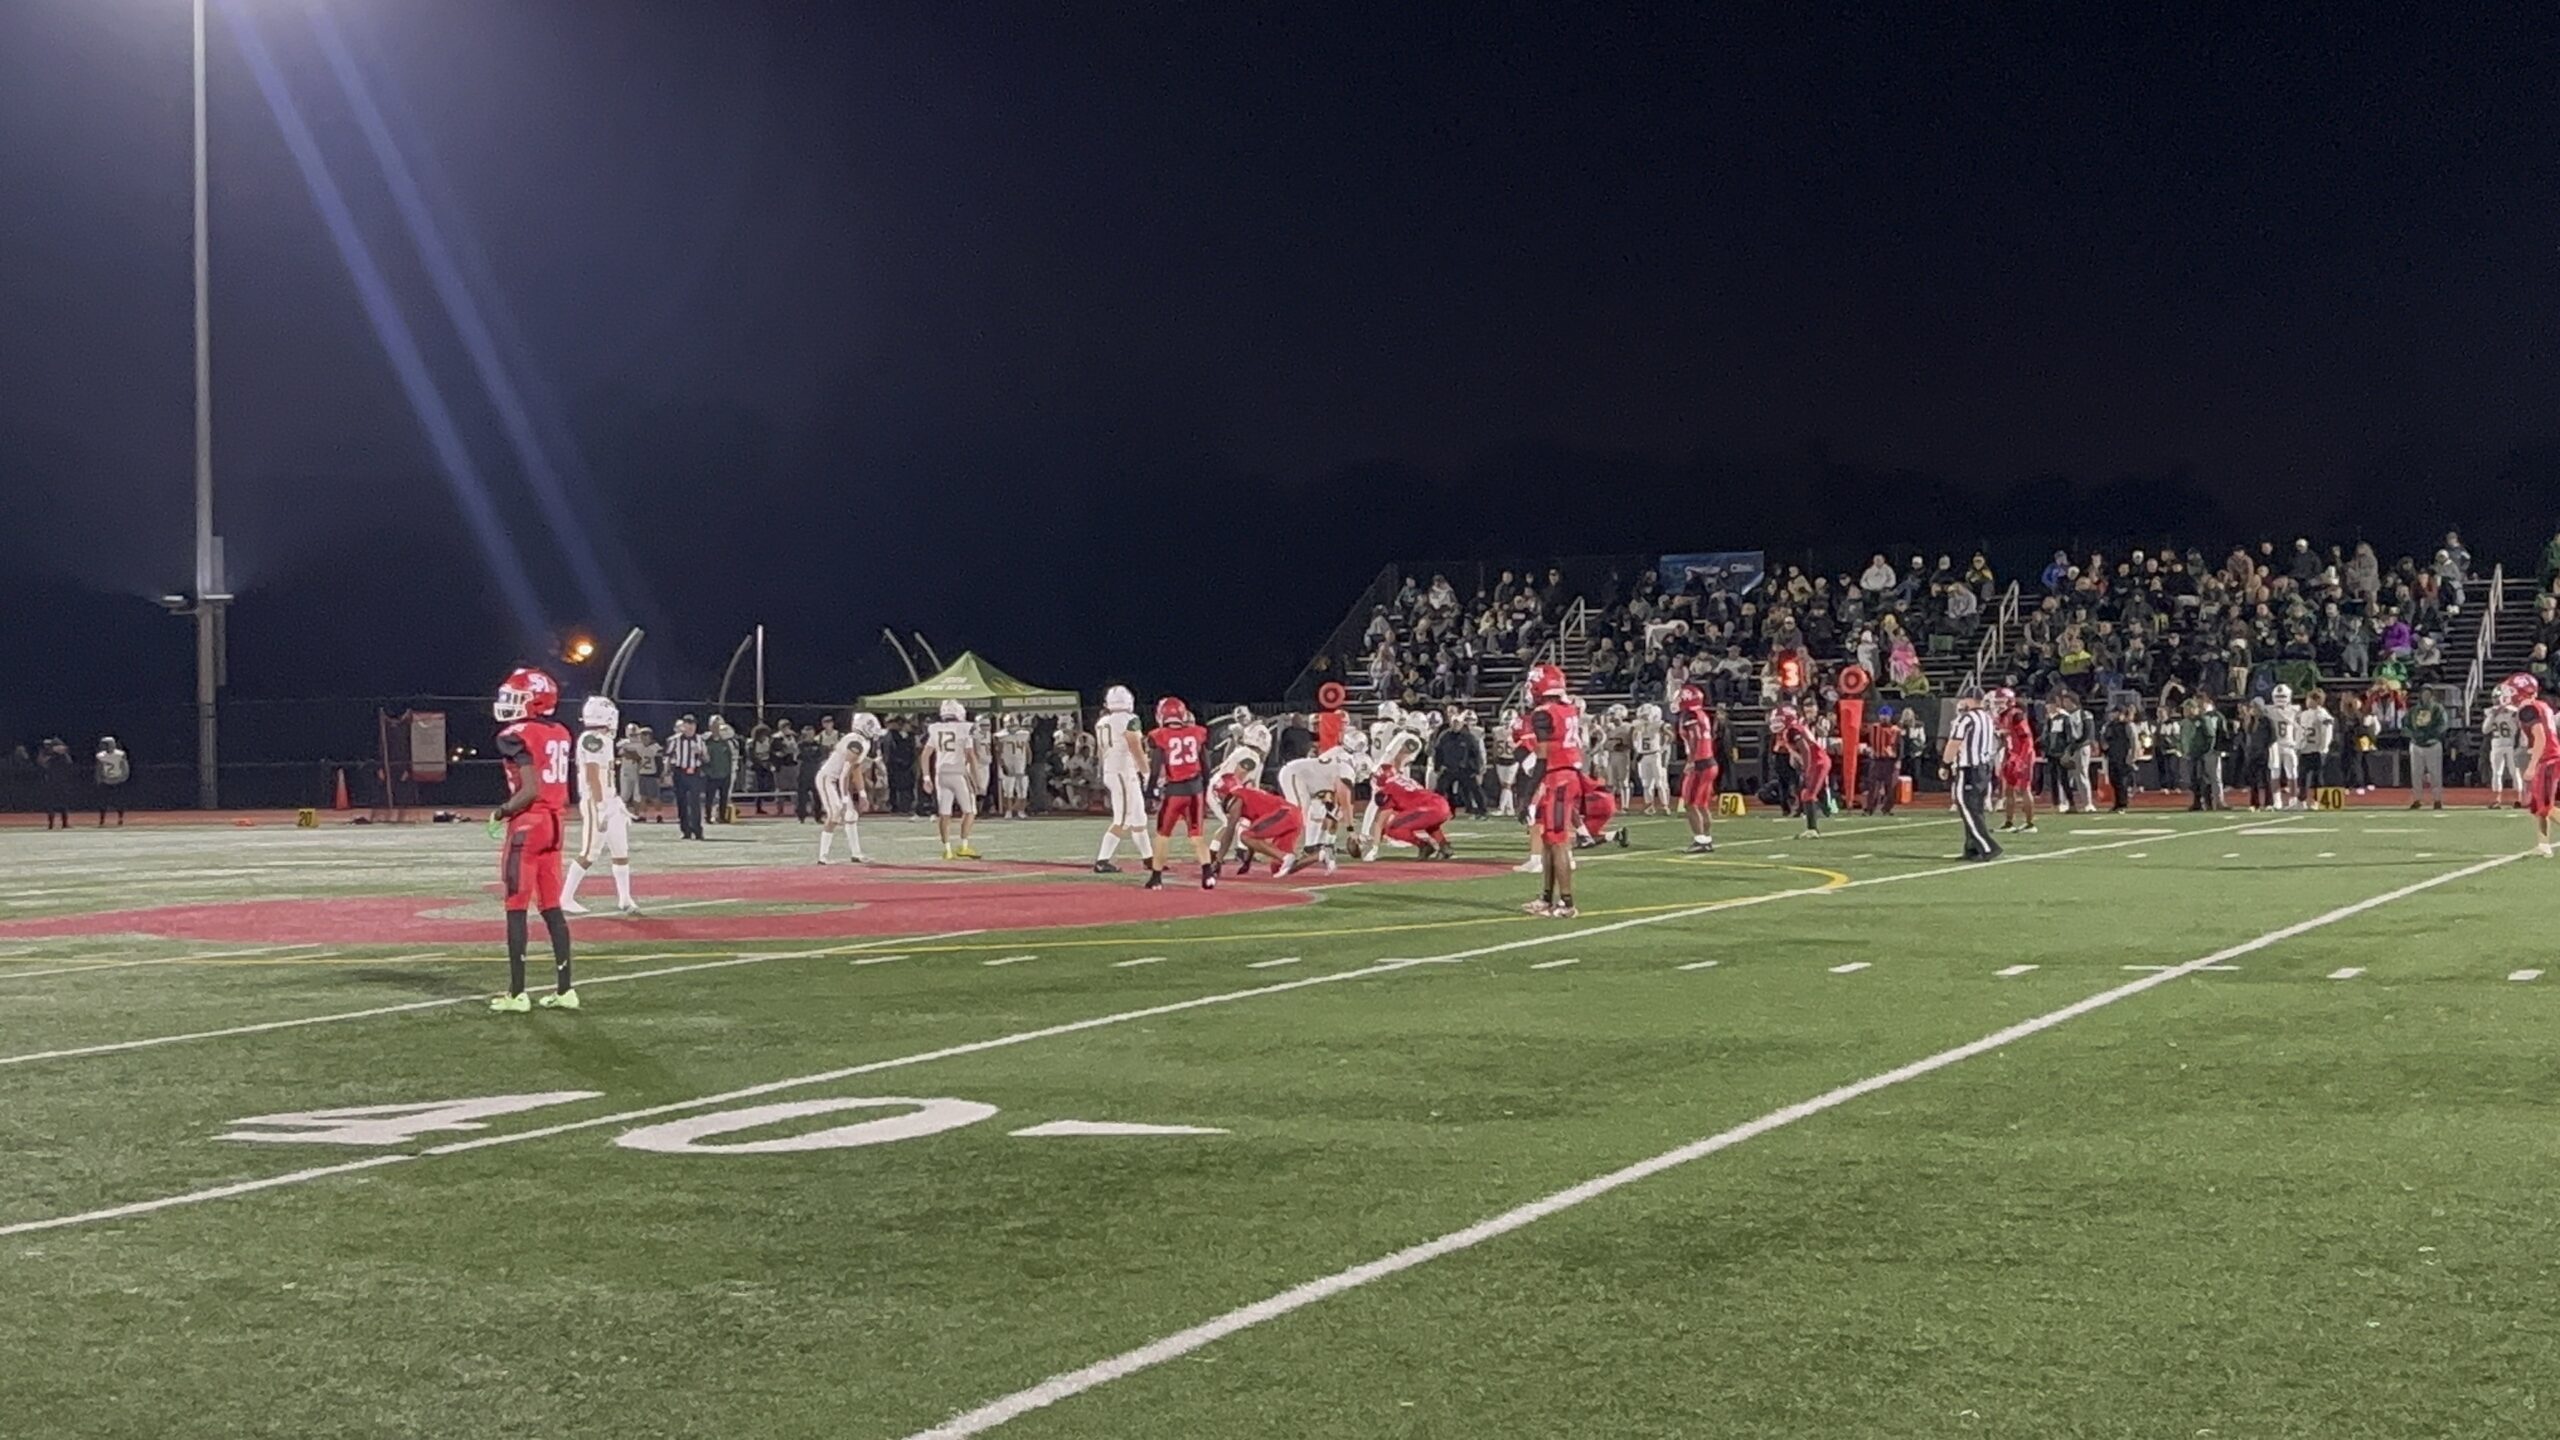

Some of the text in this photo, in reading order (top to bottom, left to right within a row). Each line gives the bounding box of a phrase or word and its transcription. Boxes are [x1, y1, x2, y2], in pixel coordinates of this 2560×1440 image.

[1782, 662, 1799, 687] 3
[2491, 721, 2511, 738] 26
[937, 731, 956, 752] 12
[1006, 740, 1026, 755] 74
[1168, 735, 1199, 766] 23
[542, 740, 570, 784] 36
[1720, 795, 1739, 815] 50
[2319, 789, 2343, 810] 40
[298, 810, 314, 827] 20
[211, 1090, 997, 1154] 40
